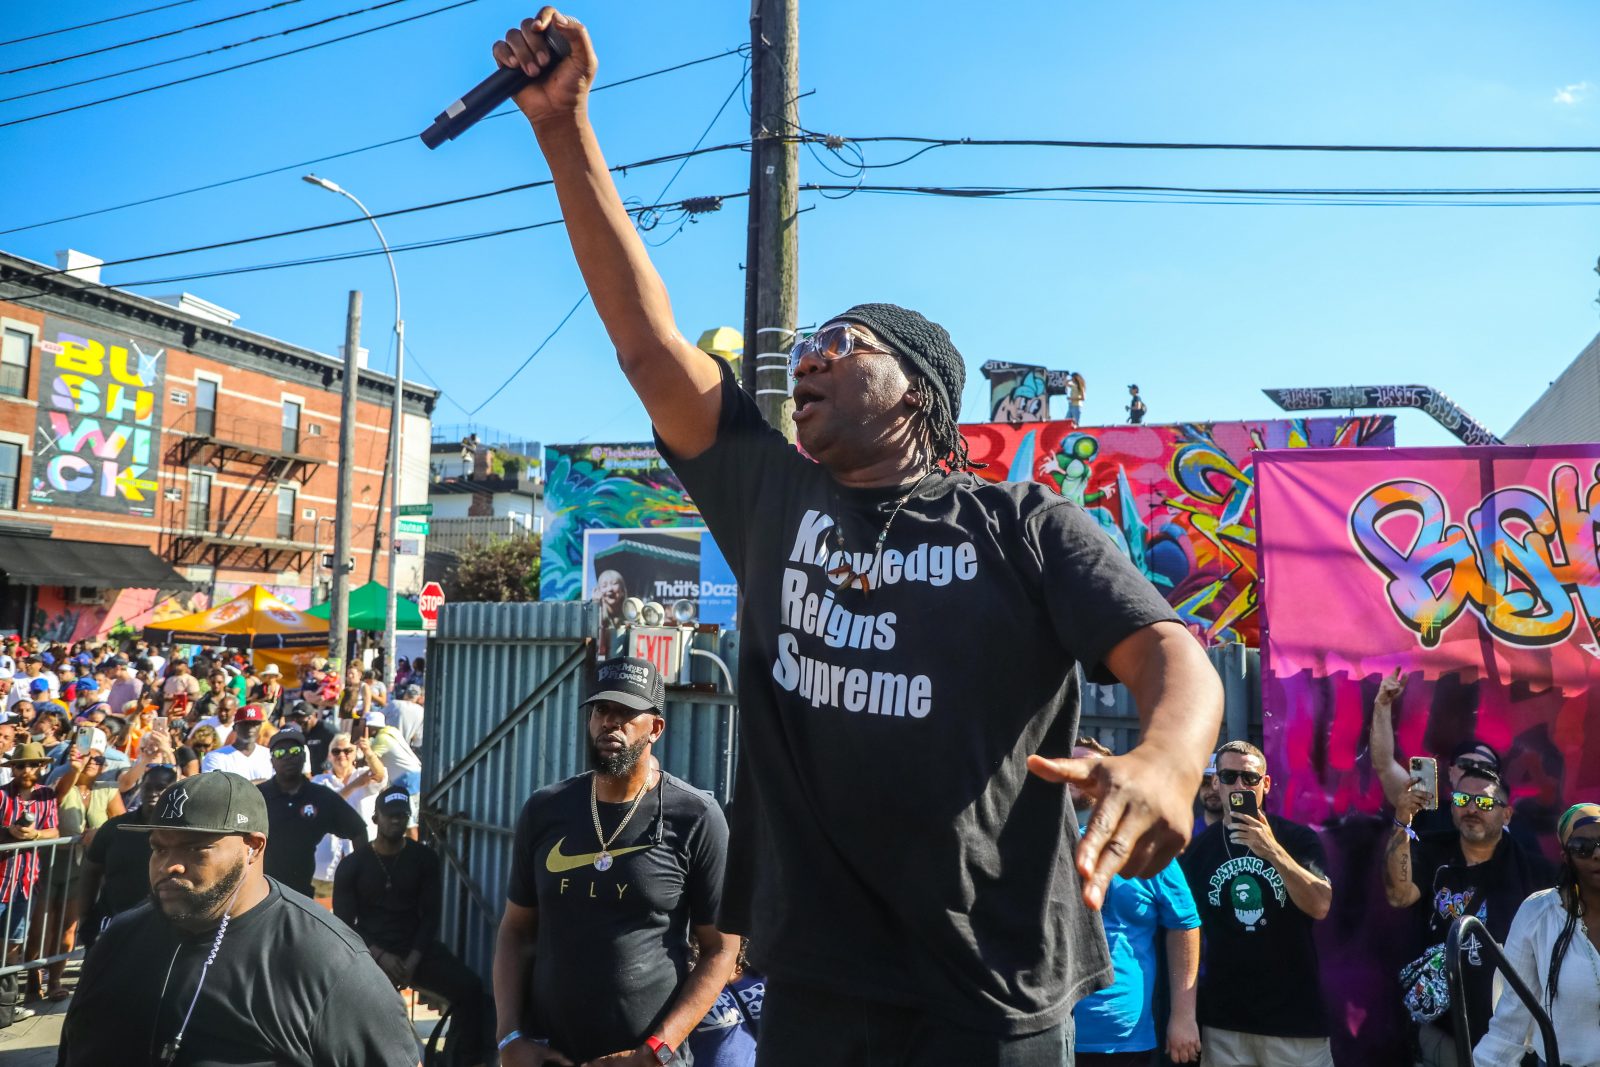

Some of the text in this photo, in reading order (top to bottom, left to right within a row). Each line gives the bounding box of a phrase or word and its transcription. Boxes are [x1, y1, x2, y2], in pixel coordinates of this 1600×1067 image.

[421, 595, 443, 612] STOP
[654, 580, 700, 598] Thät's
[781, 567, 897, 651] Reigns
[772, 632, 932, 719] Supreme
[1209, 856, 1264, 893] BATHING
